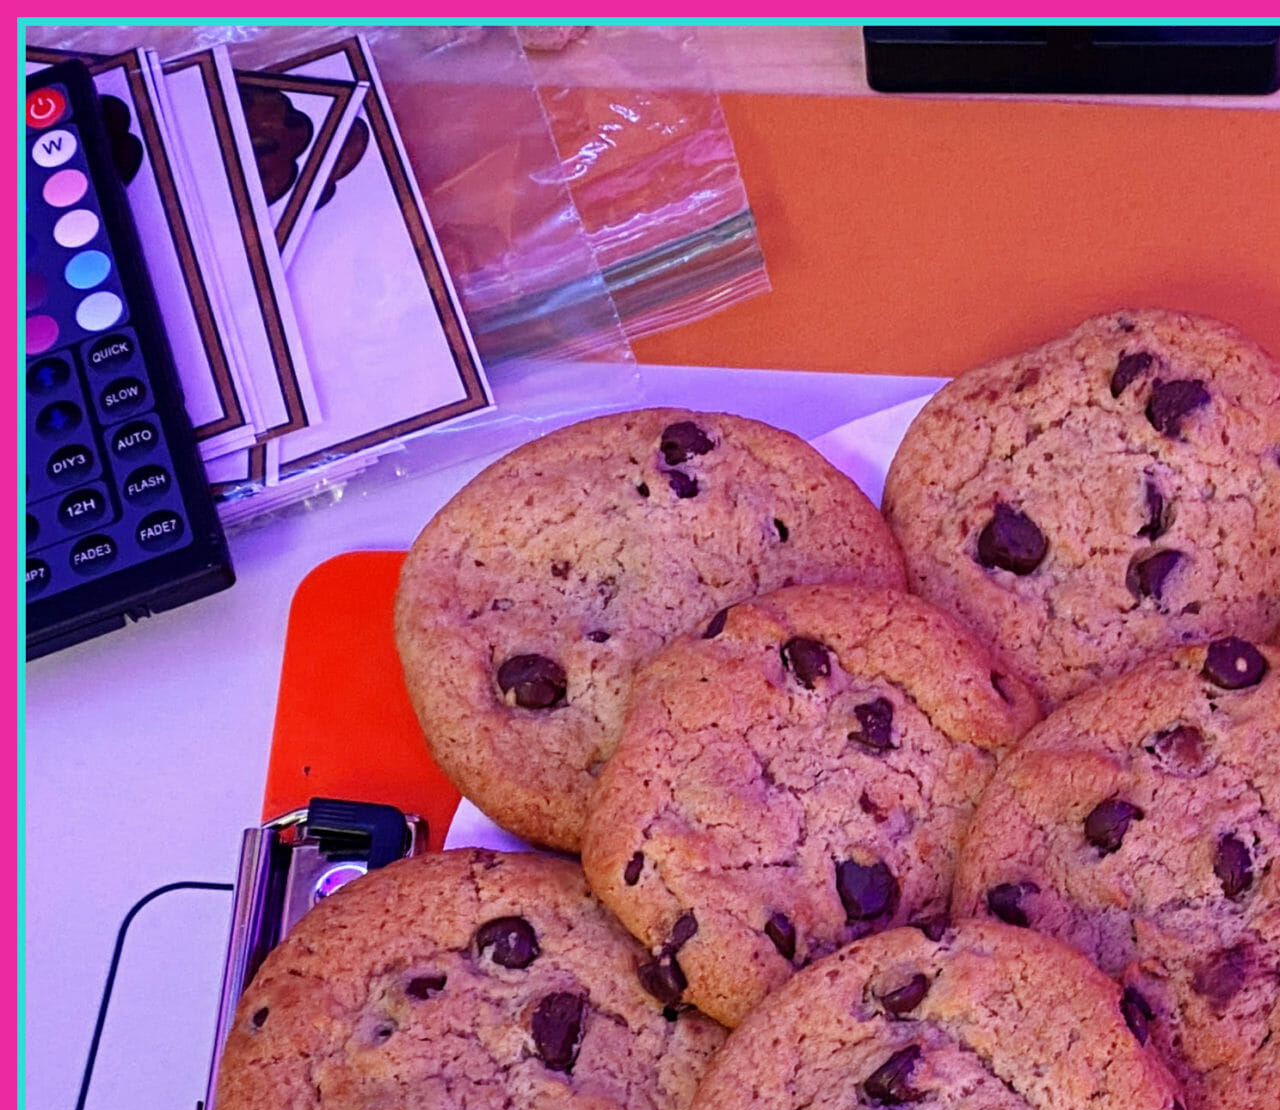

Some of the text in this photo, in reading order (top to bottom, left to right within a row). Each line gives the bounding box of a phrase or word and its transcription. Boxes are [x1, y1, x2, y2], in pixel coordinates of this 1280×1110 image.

[42, 137, 63, 156] W
[92, 342, 129, 363] QUICK
[105, 386, 139, 406] SLOW
[117, 430, 152, 451] AUTO
[52, 453, 86, 473] DIY3
[128, 474, 166, 496] FLASH
[66, 498, 96, 518] 12H
[140, 519, 177, 541] FADE7
[74, 543, 112, 565] FADE3
